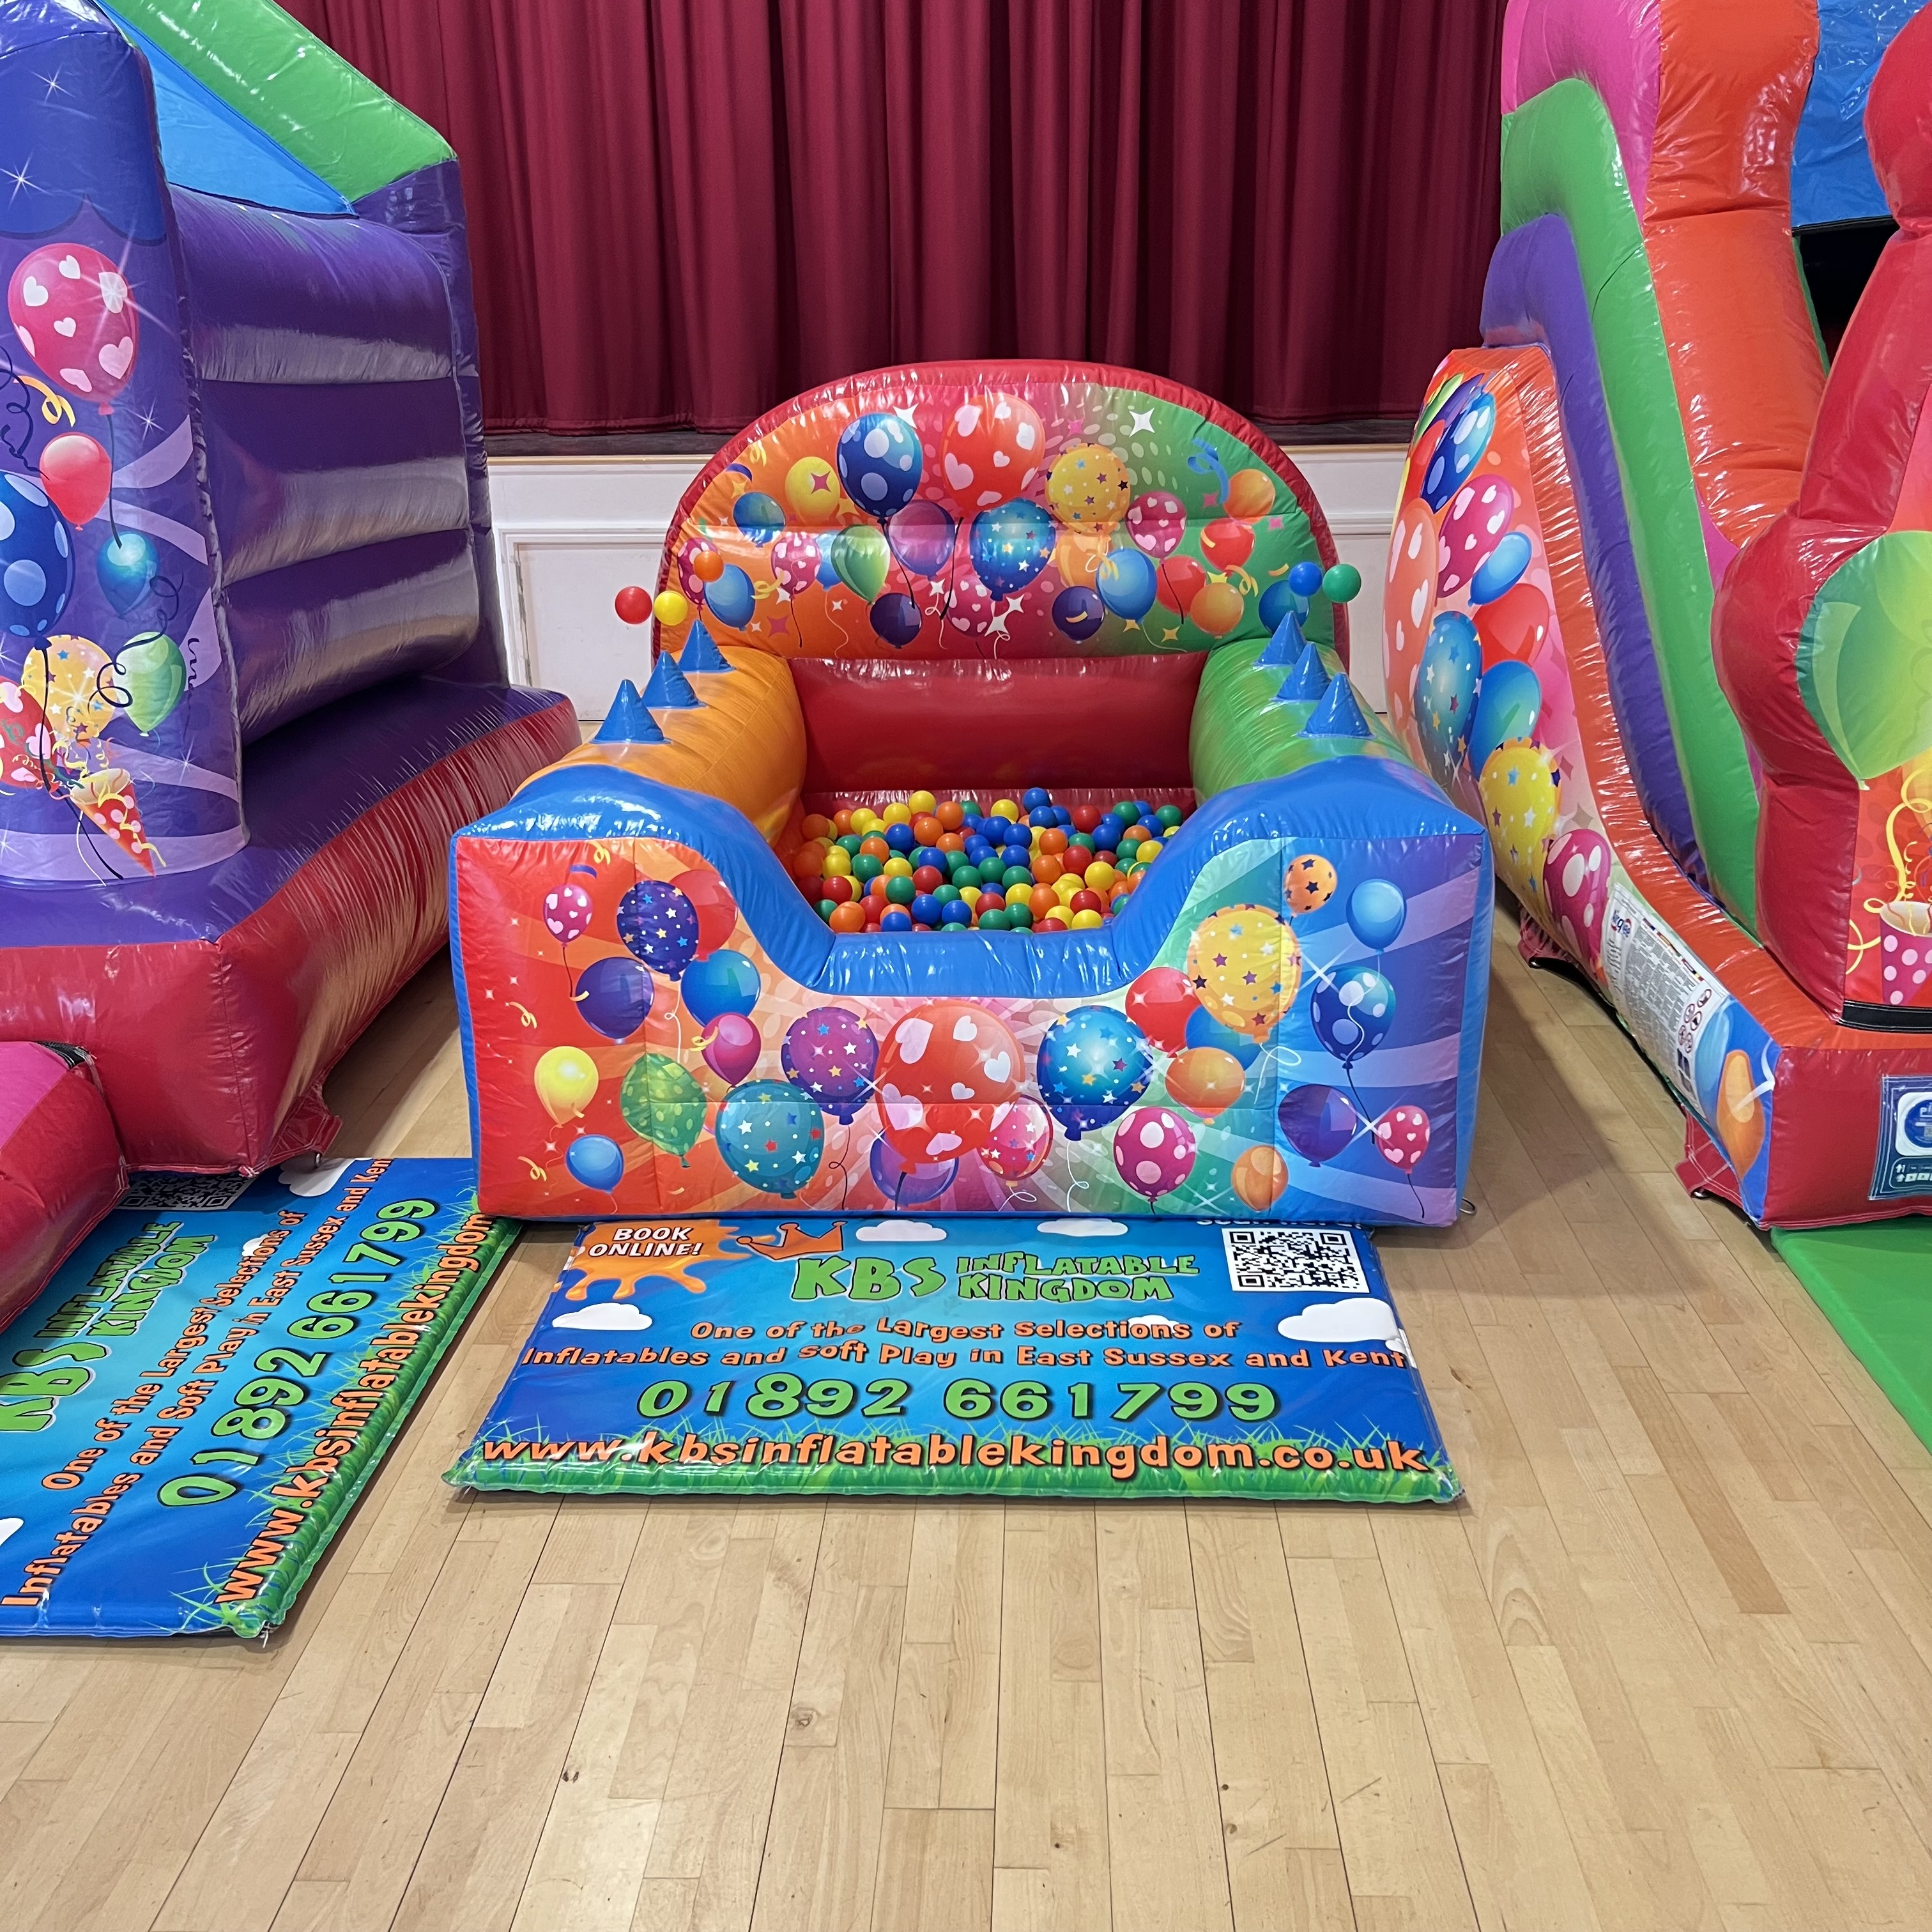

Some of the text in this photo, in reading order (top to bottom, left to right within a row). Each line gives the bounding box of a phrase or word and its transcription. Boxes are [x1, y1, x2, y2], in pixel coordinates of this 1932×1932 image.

[588, 1243, 703, 1257] ONLINE!
[612, 1227, 693, 1242] BOOK
[33, 1221, 184, 1338] INFLATABLE
[86, 1234, 217, 1336] KINGDOM
[792, 1255, 946, 1301] KBS
[956, 1251, 1200, 1276] INFLATABLE
[958, 1273, 1174, 1302] KINGDOM
[41, 1210, 308, 1490] One of the Largest Selections of
[157, 1199, 438, 1507] 01892 661799
[691, 1317, 1242, 1342] One of the Largest Selections of
[521, 1346, 710, 1367] Inflatables
[720, 1347, 786, 1366] and
[879, 1345, 957, 1368] Play
[969, 1348, 1003, 1364] in
[1016, 1346, 1092, 1367] East
[1103, 1347, 1233, 1367] Sussex
[1245, 1350, 1310, 1368] and
[1323, 1349, 1407, 1368] Kent
[0, 1158, 395, 1607] Inflatables and Soft Play in East Sussex and Ken
[637, 1372, 1279, 1422] 01892 661799
[482, 1430, 1430, 1480] www.kbsinflatablekingdom.co.uk
